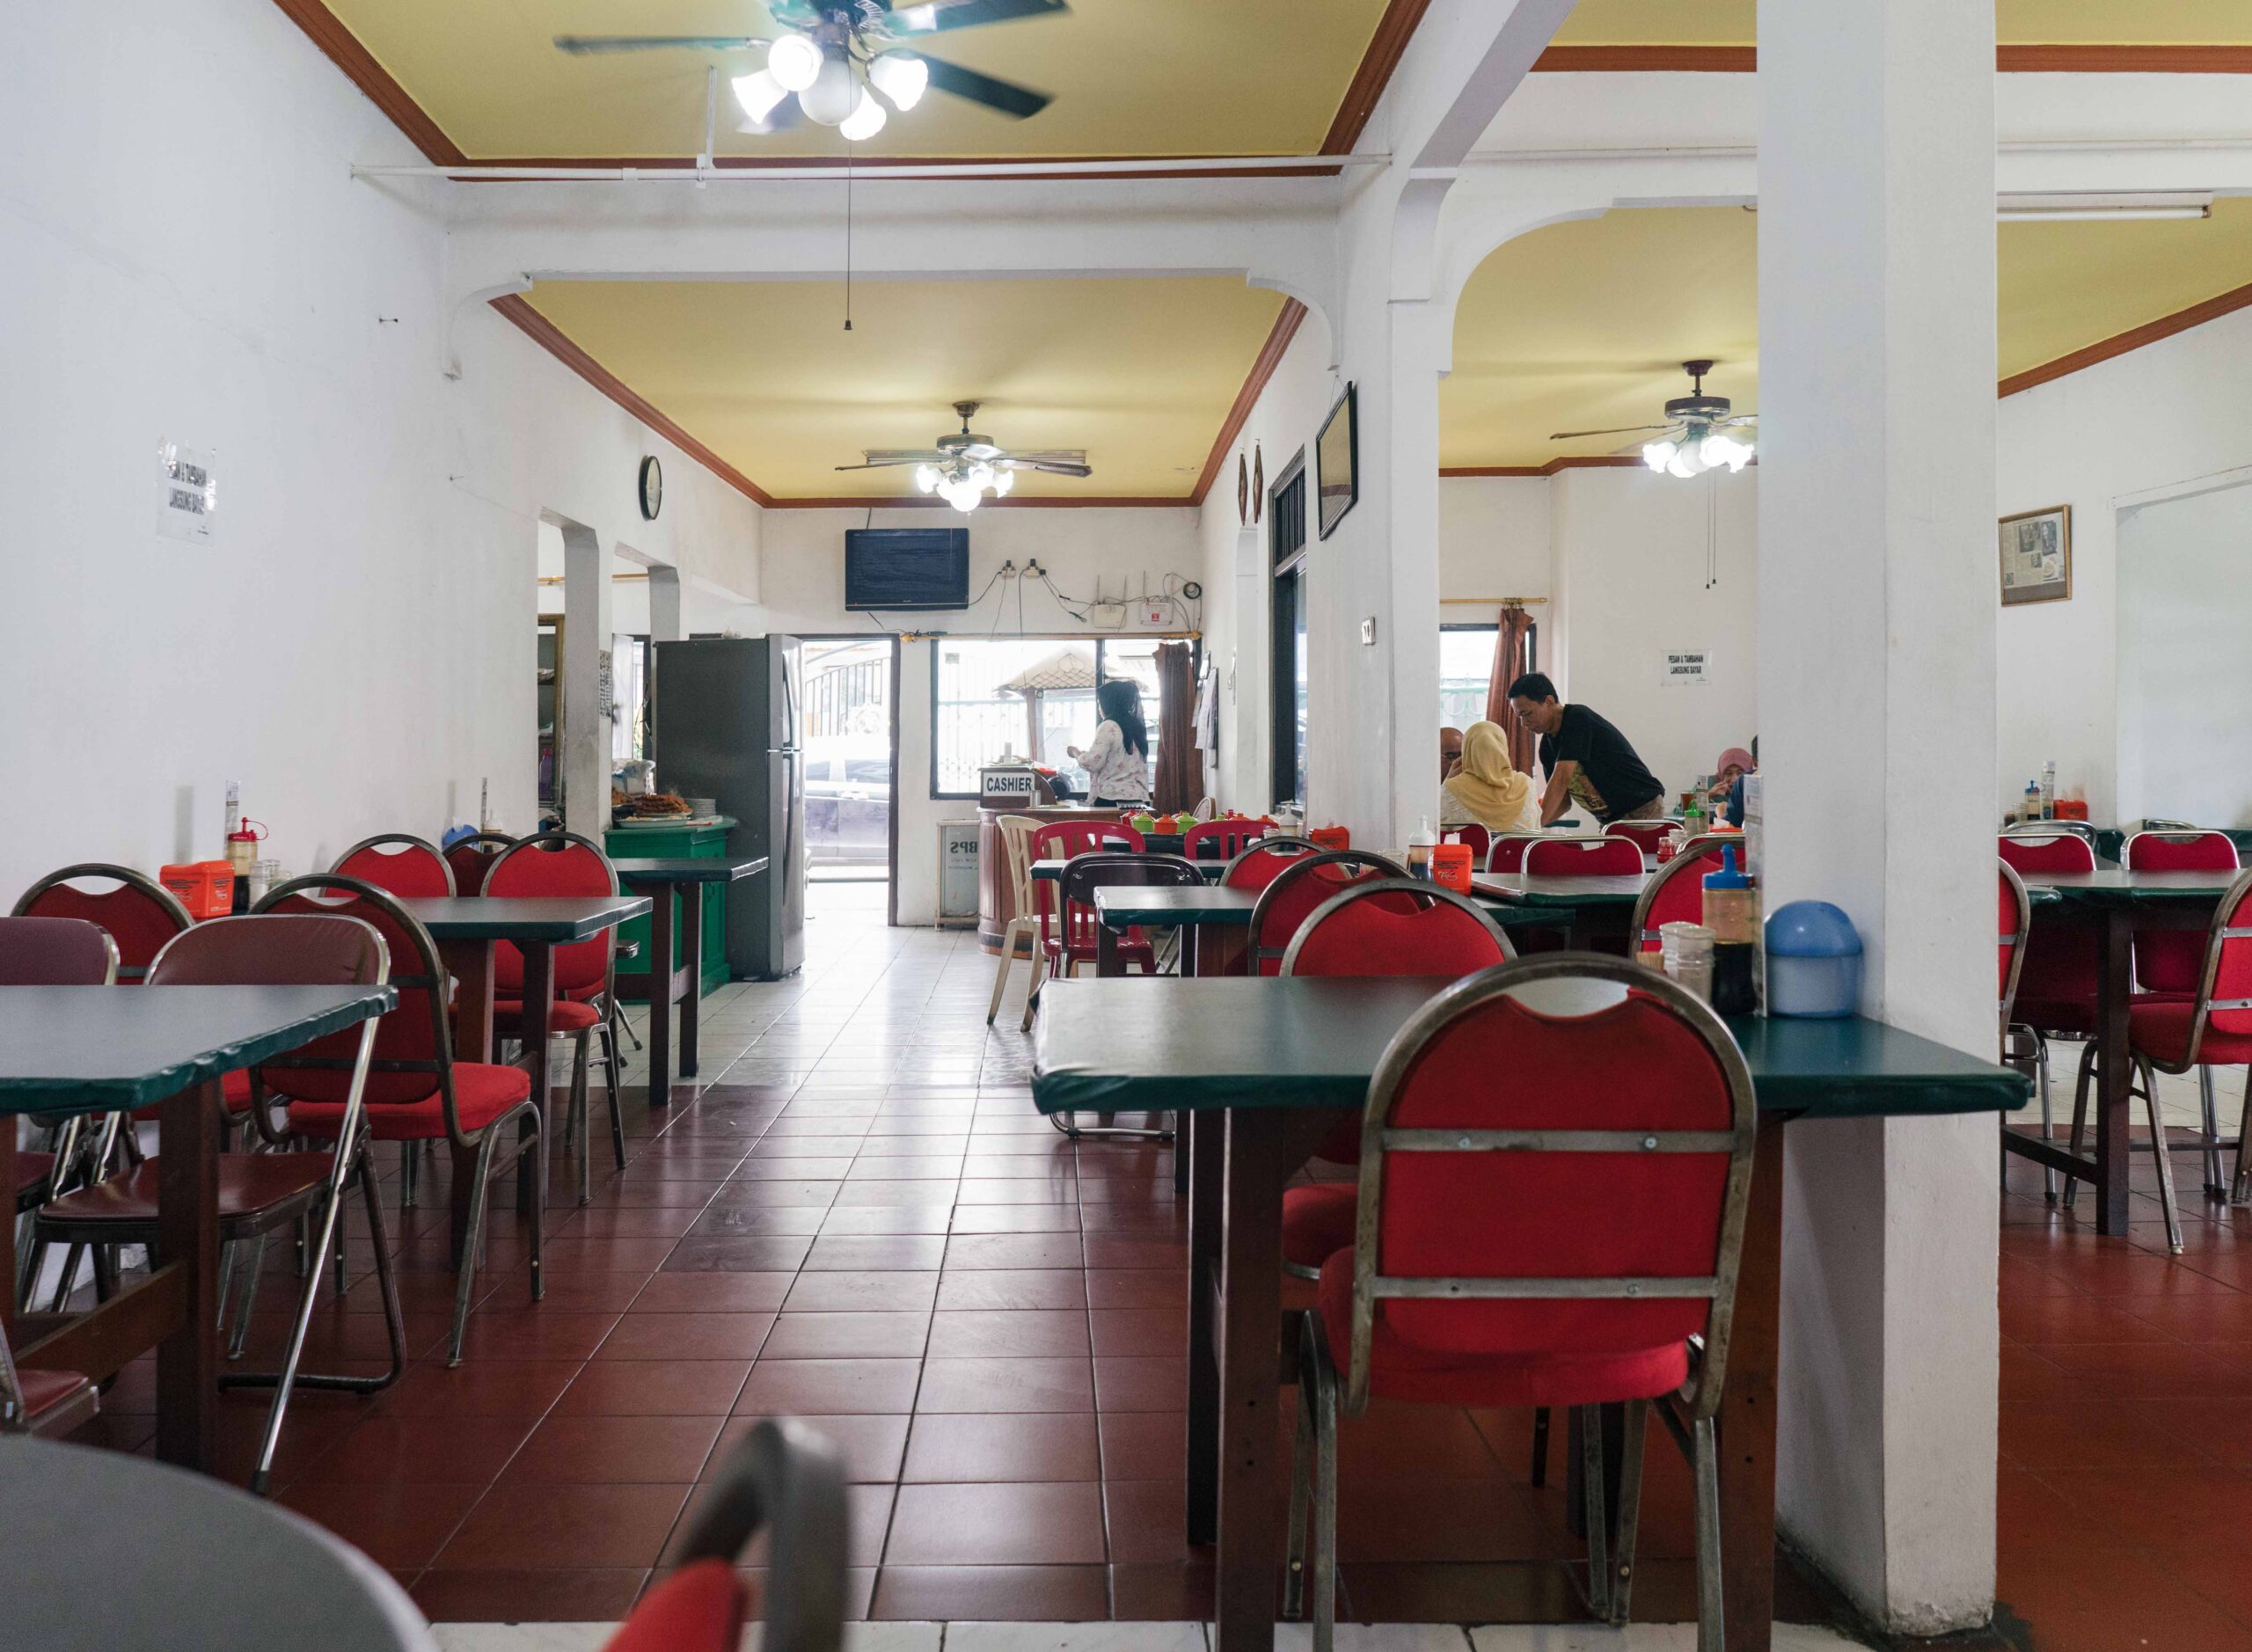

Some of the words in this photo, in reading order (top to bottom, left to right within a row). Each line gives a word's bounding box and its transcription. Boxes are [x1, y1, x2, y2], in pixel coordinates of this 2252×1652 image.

[1668, 654, 1680, 663] PESAN
[1684, 654, 1704, 663] TAMBAHAN
[1670, 665, 1690, 675] LANGSUNG
[1690, 665, 1702, 675] BAYAR
[986, 777, 1032, 792] CASHIER
